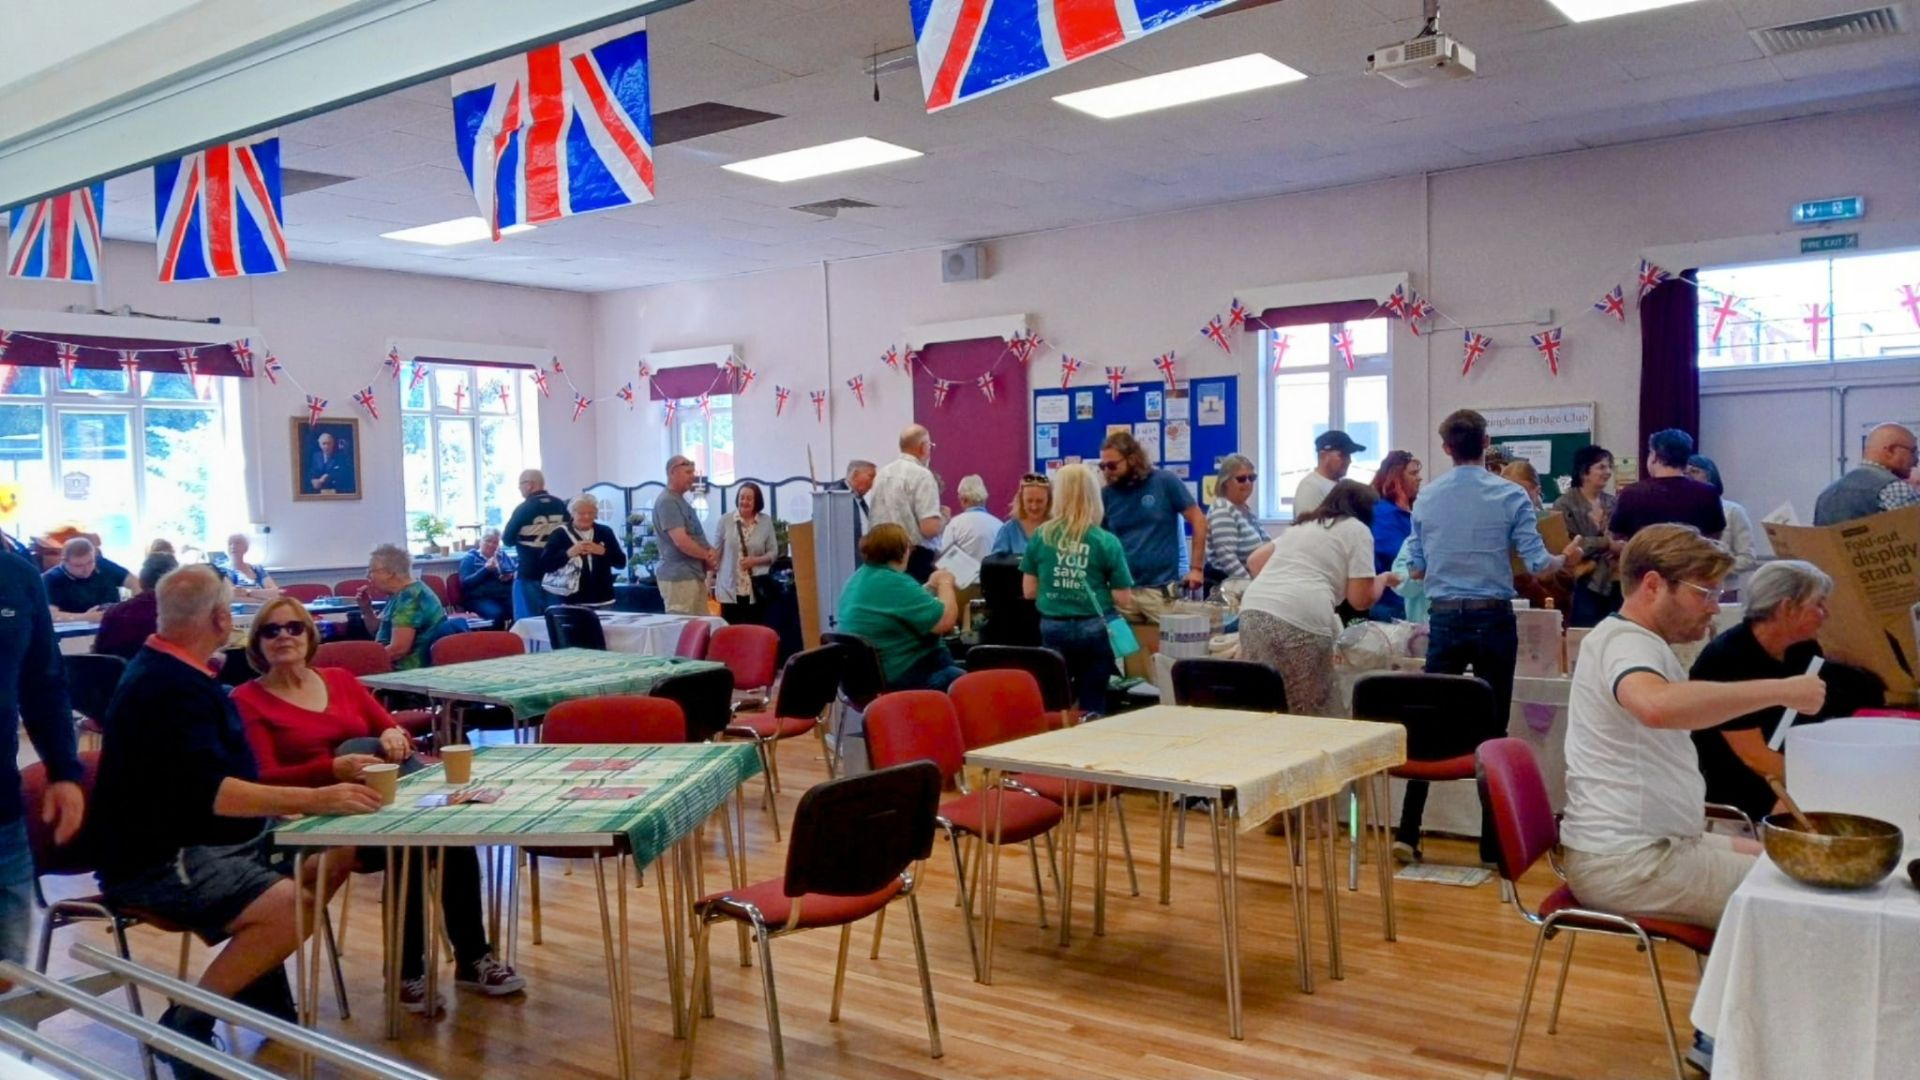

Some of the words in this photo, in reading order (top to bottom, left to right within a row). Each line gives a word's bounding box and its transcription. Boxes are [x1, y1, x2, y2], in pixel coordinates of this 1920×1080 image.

[1803, 239, 1821, 248] FIRE
[1824, 238, 1842, 247] EXIT
[1529, 414, 1561, 425] Bridge
[1564, 413, 1588, 423] Club
[1844, 531, 1901, 553] Fold-out
[1056, 552, 1088, 569] YOU
[1852, 541, 1918, 568] display
[1053, 566, 1087, 578] save
[1859, 560, 1912, 584] stand
[1053, 579, 1061, 587] a
